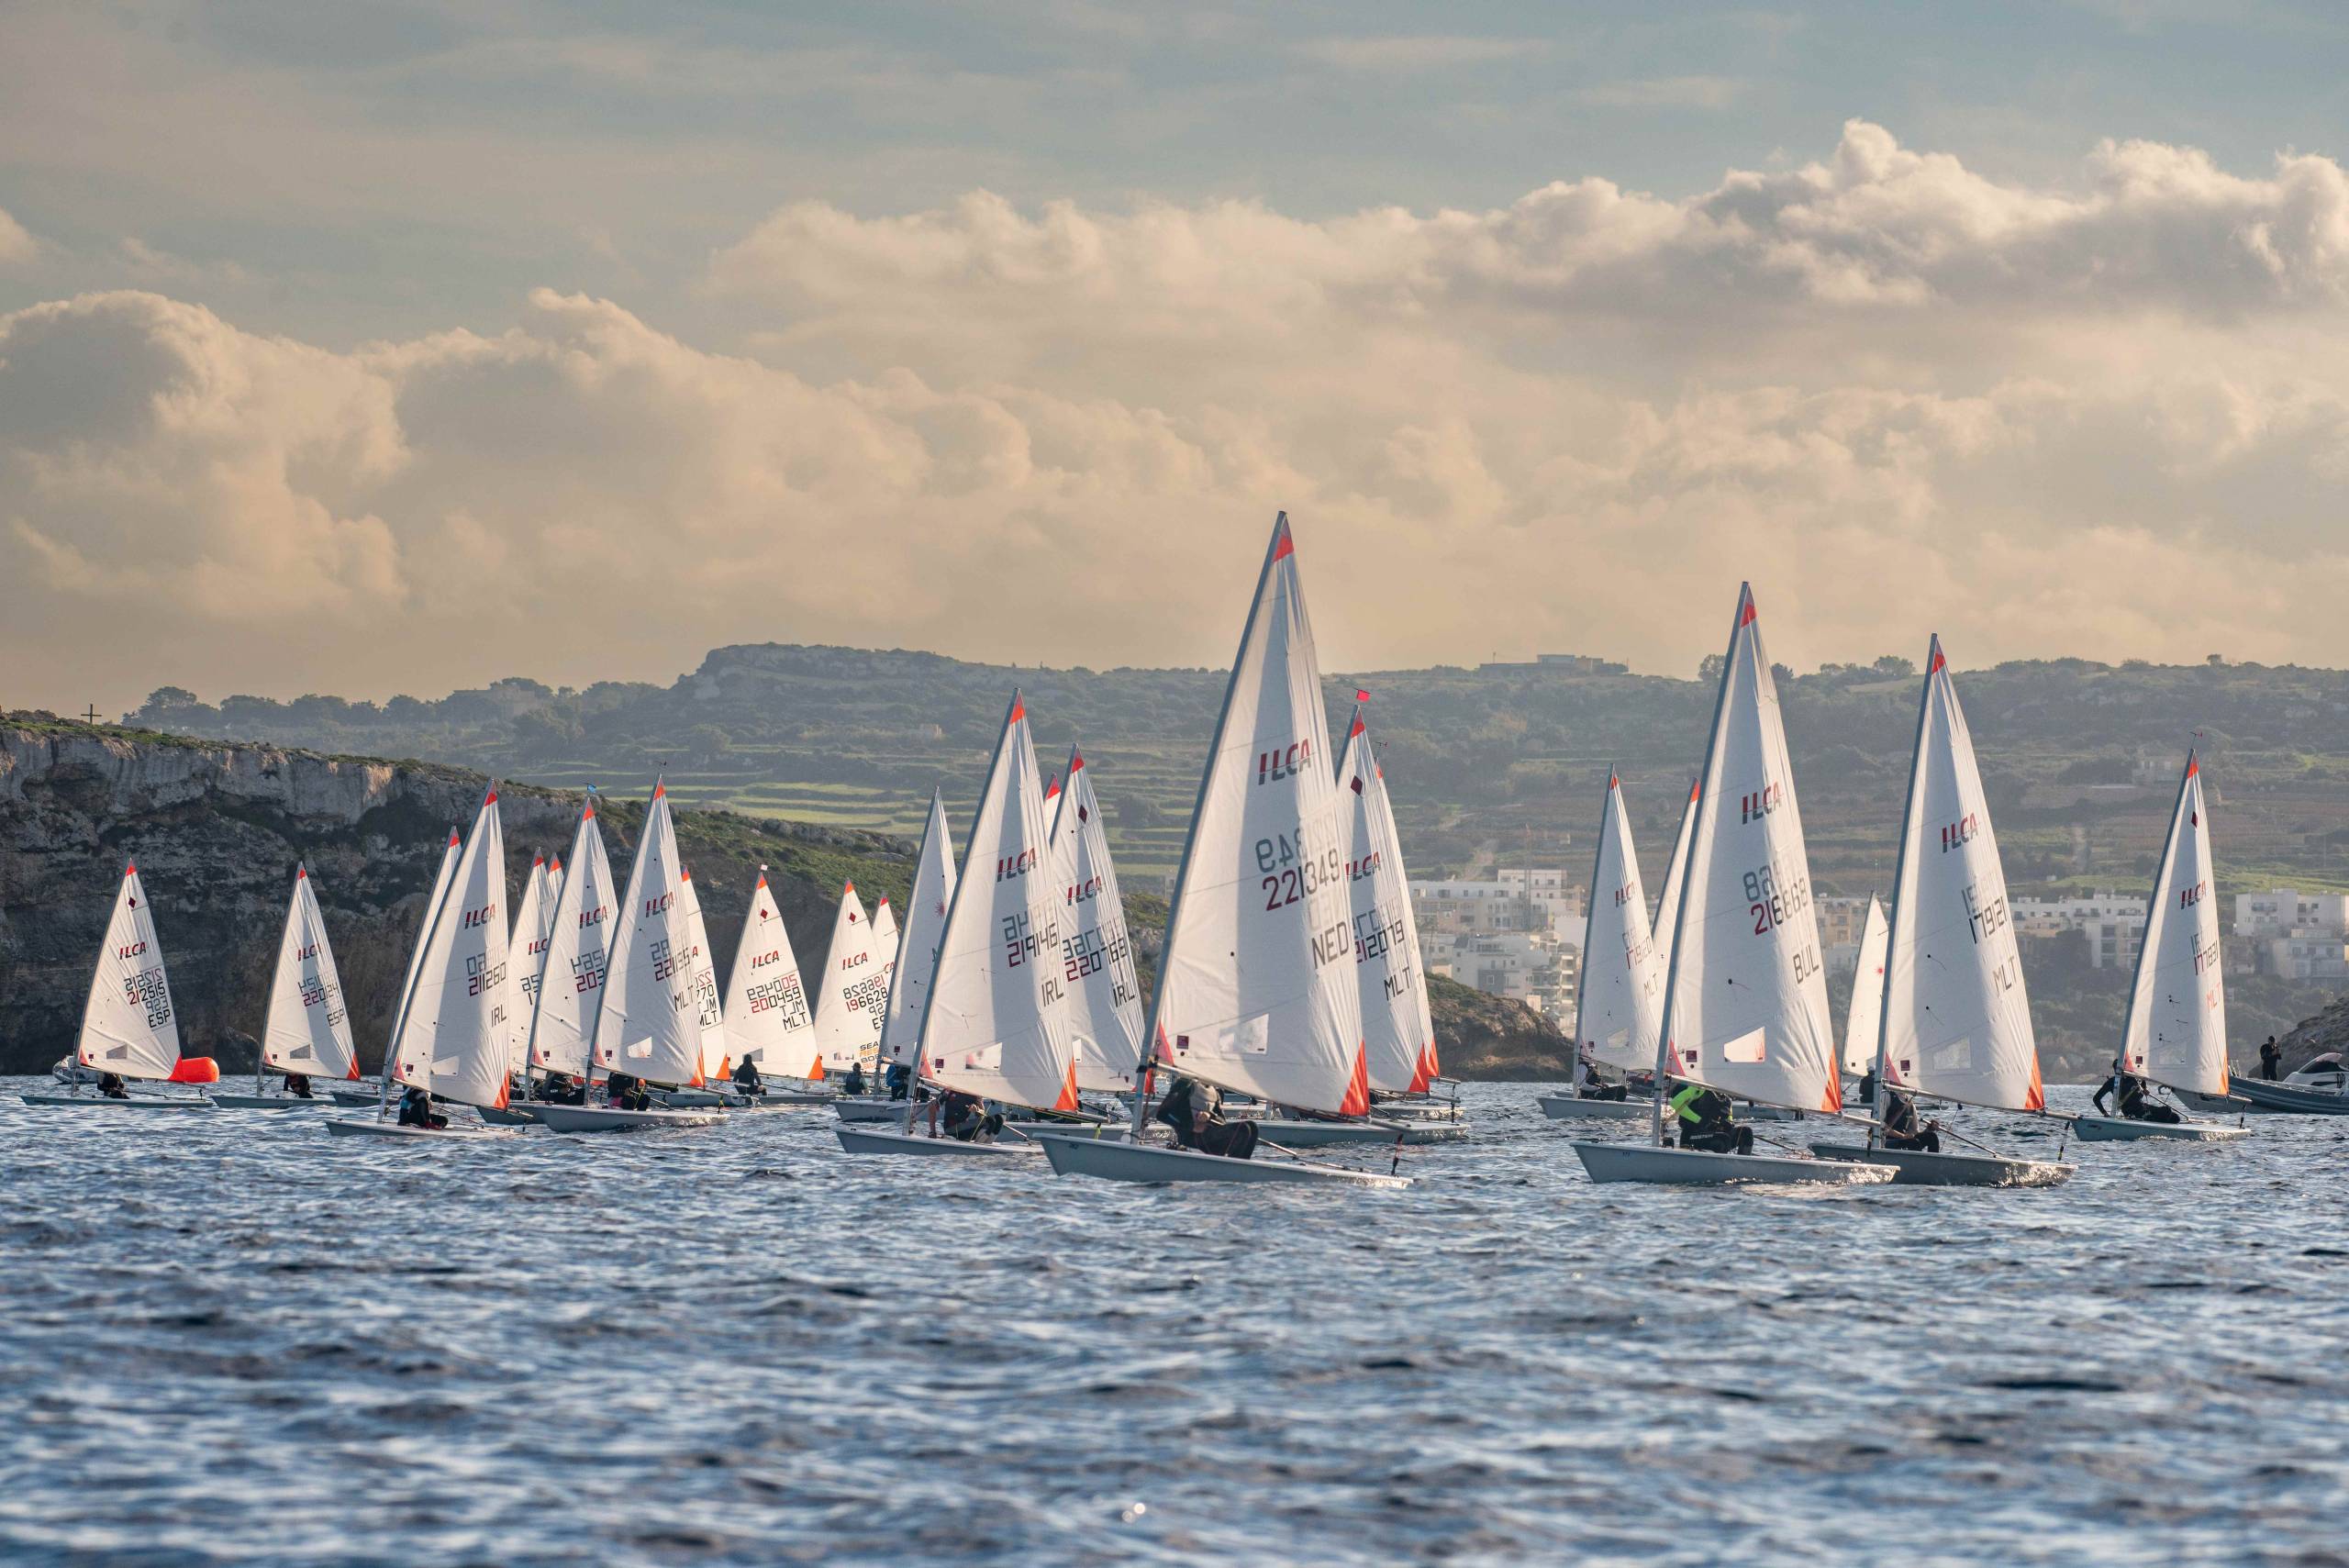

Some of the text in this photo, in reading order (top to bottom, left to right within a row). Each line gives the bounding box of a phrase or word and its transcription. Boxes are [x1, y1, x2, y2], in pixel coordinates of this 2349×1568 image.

[1258, 738, 1312, 786] ILCA
[1742, 781, 1782, 825] ILCA
[1942, 812, 1978, 853] ILCA
[996, 847, 1037, 883] ILCA
[1345, 851, 1381, 882] ILCA
[1067, 875, 1103, 906] ILCA
[1262, 848, 1341, 912] 221349
[464, 903, 495, 929] ILCA
[579, 905, 608, 929] ILCA
[645, 891, 674, 917] ILCA
[119, 942, 147, 960] ILCA
[529, 938, 548, 955] ILC
[1007, 922, 1058, 968] 219146
[1311, 921, 1350, 970] NED
[752, 951, 780, 969] ILCA
[841, 951, 868, 971] ILCA
[1793, 943, 1820, 984] BUL
[468, 962, 507, 996] 211260
[574, 968, 605, 993] 203
[1384, 966, 1411, 1002] MLT
[1992, 955, 2017, 999] MLT
[128, 982, 165, 1005] 212515
[674, 984, 694, 1012] MLT
[750, 985, 801, 1013] 200459
[846, 986, 888, 1012] 196628
[1041, 977, 1064, 1007] IRL
[1112, 981, 1136, 1008] IRL
[148, 1009, 171, 1028] ESP
[327, 1008, 344, 1027] ESP
[491, 1004, 507, 1028] IRL
[782, 1011, 807, 1030] MLT
